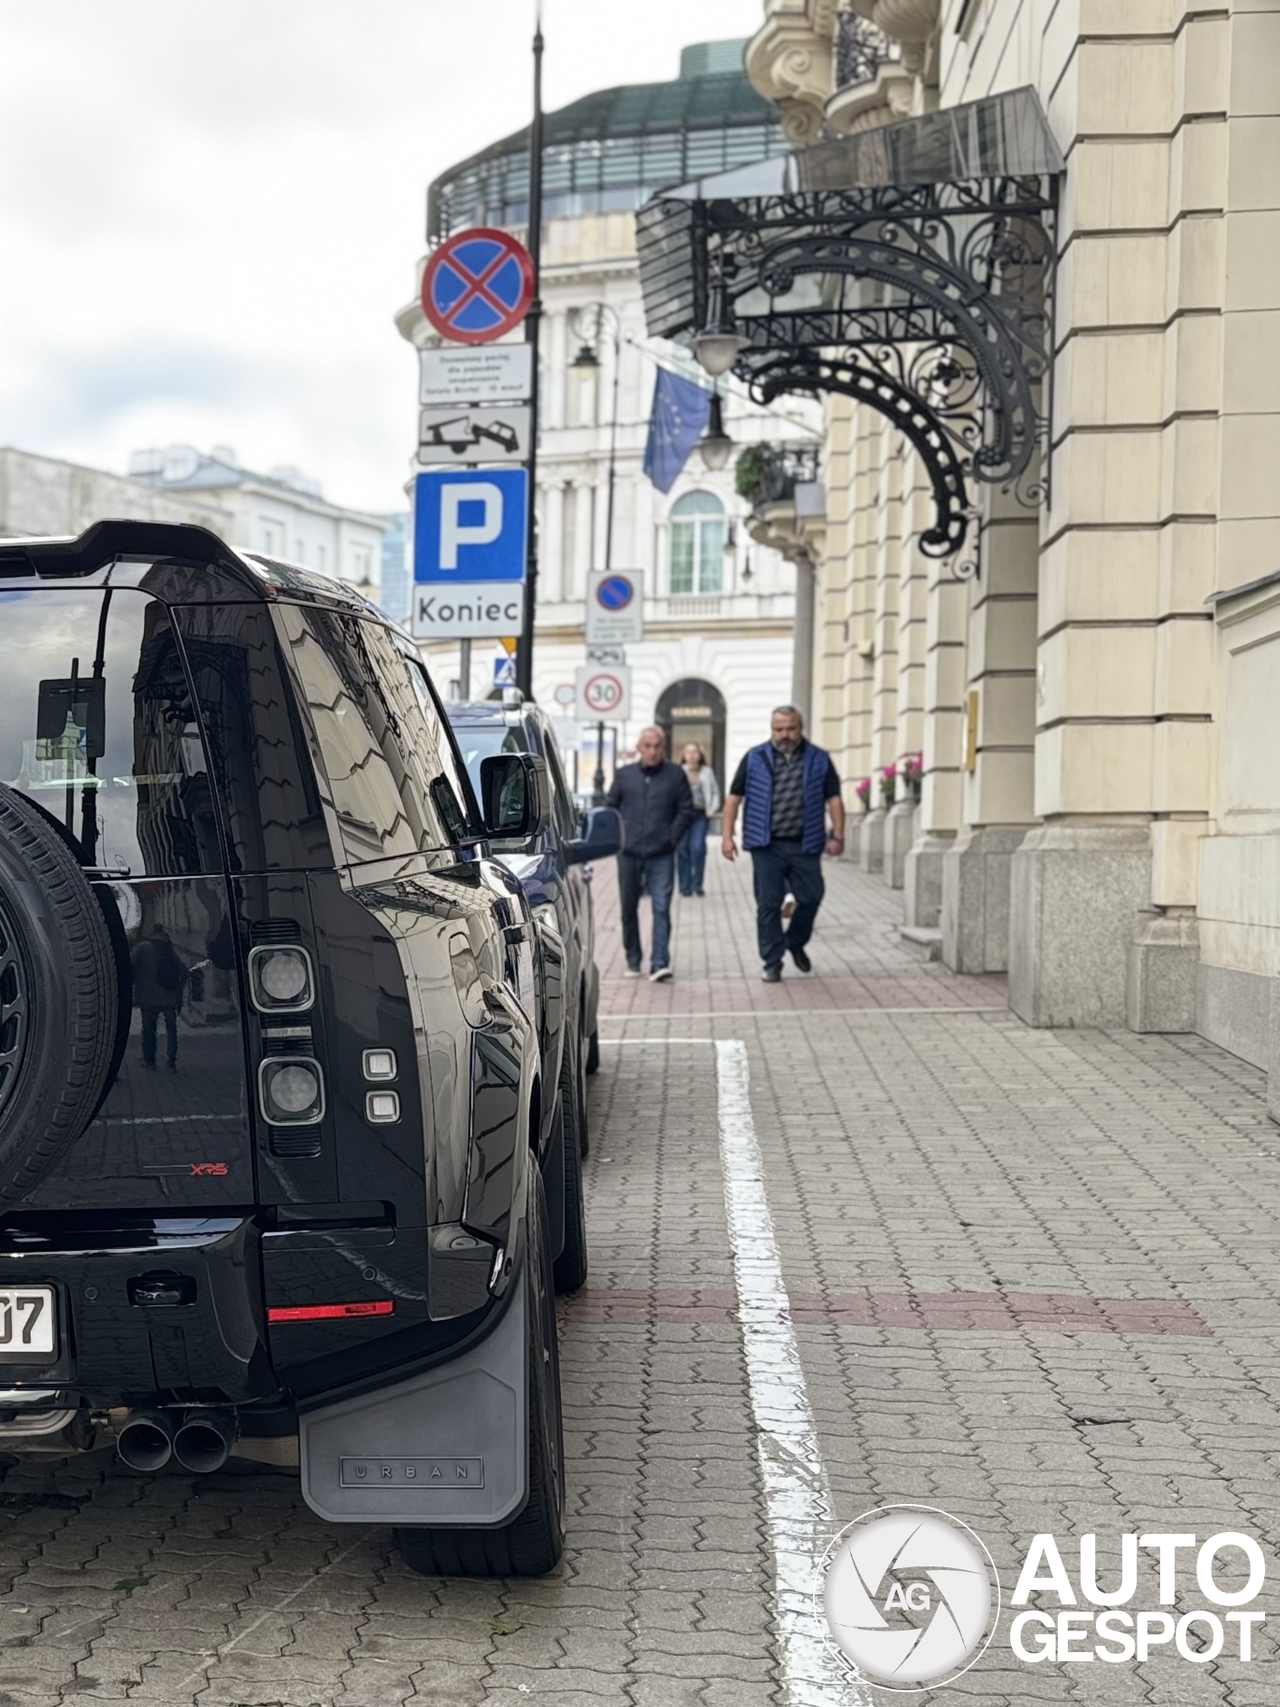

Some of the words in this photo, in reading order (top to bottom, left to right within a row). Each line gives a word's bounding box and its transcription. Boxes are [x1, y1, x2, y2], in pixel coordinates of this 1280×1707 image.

[439, 482, 503, 570] P
[419, 595, 519, 623] Koniec
[592, 684, 617, 702] 30
[355, 1466, 468, 1479] URBAN
